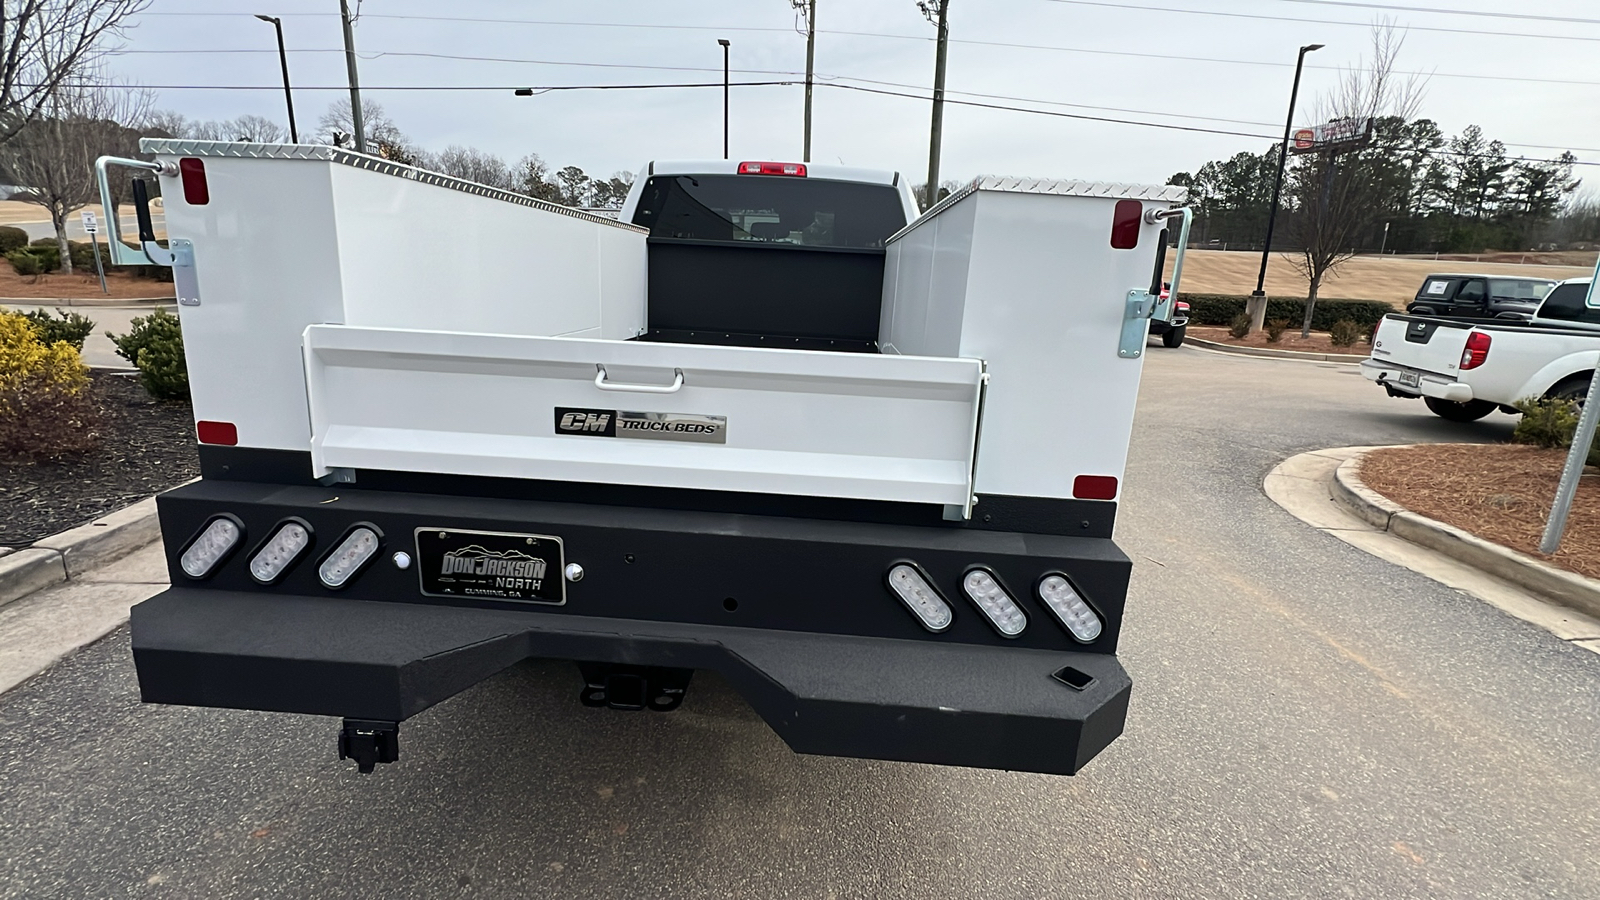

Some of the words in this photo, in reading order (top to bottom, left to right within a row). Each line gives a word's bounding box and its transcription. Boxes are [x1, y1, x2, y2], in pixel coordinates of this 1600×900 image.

[560, 412, 610, 432] CM
[621, 420, 671, 432] TRUCK
[674, 423, 717, 434] BEDS
[441, 555, 475, 575] DON
[475, 557, 547, 579] JACKSON
[495, 577, 542, 590] NORTH
